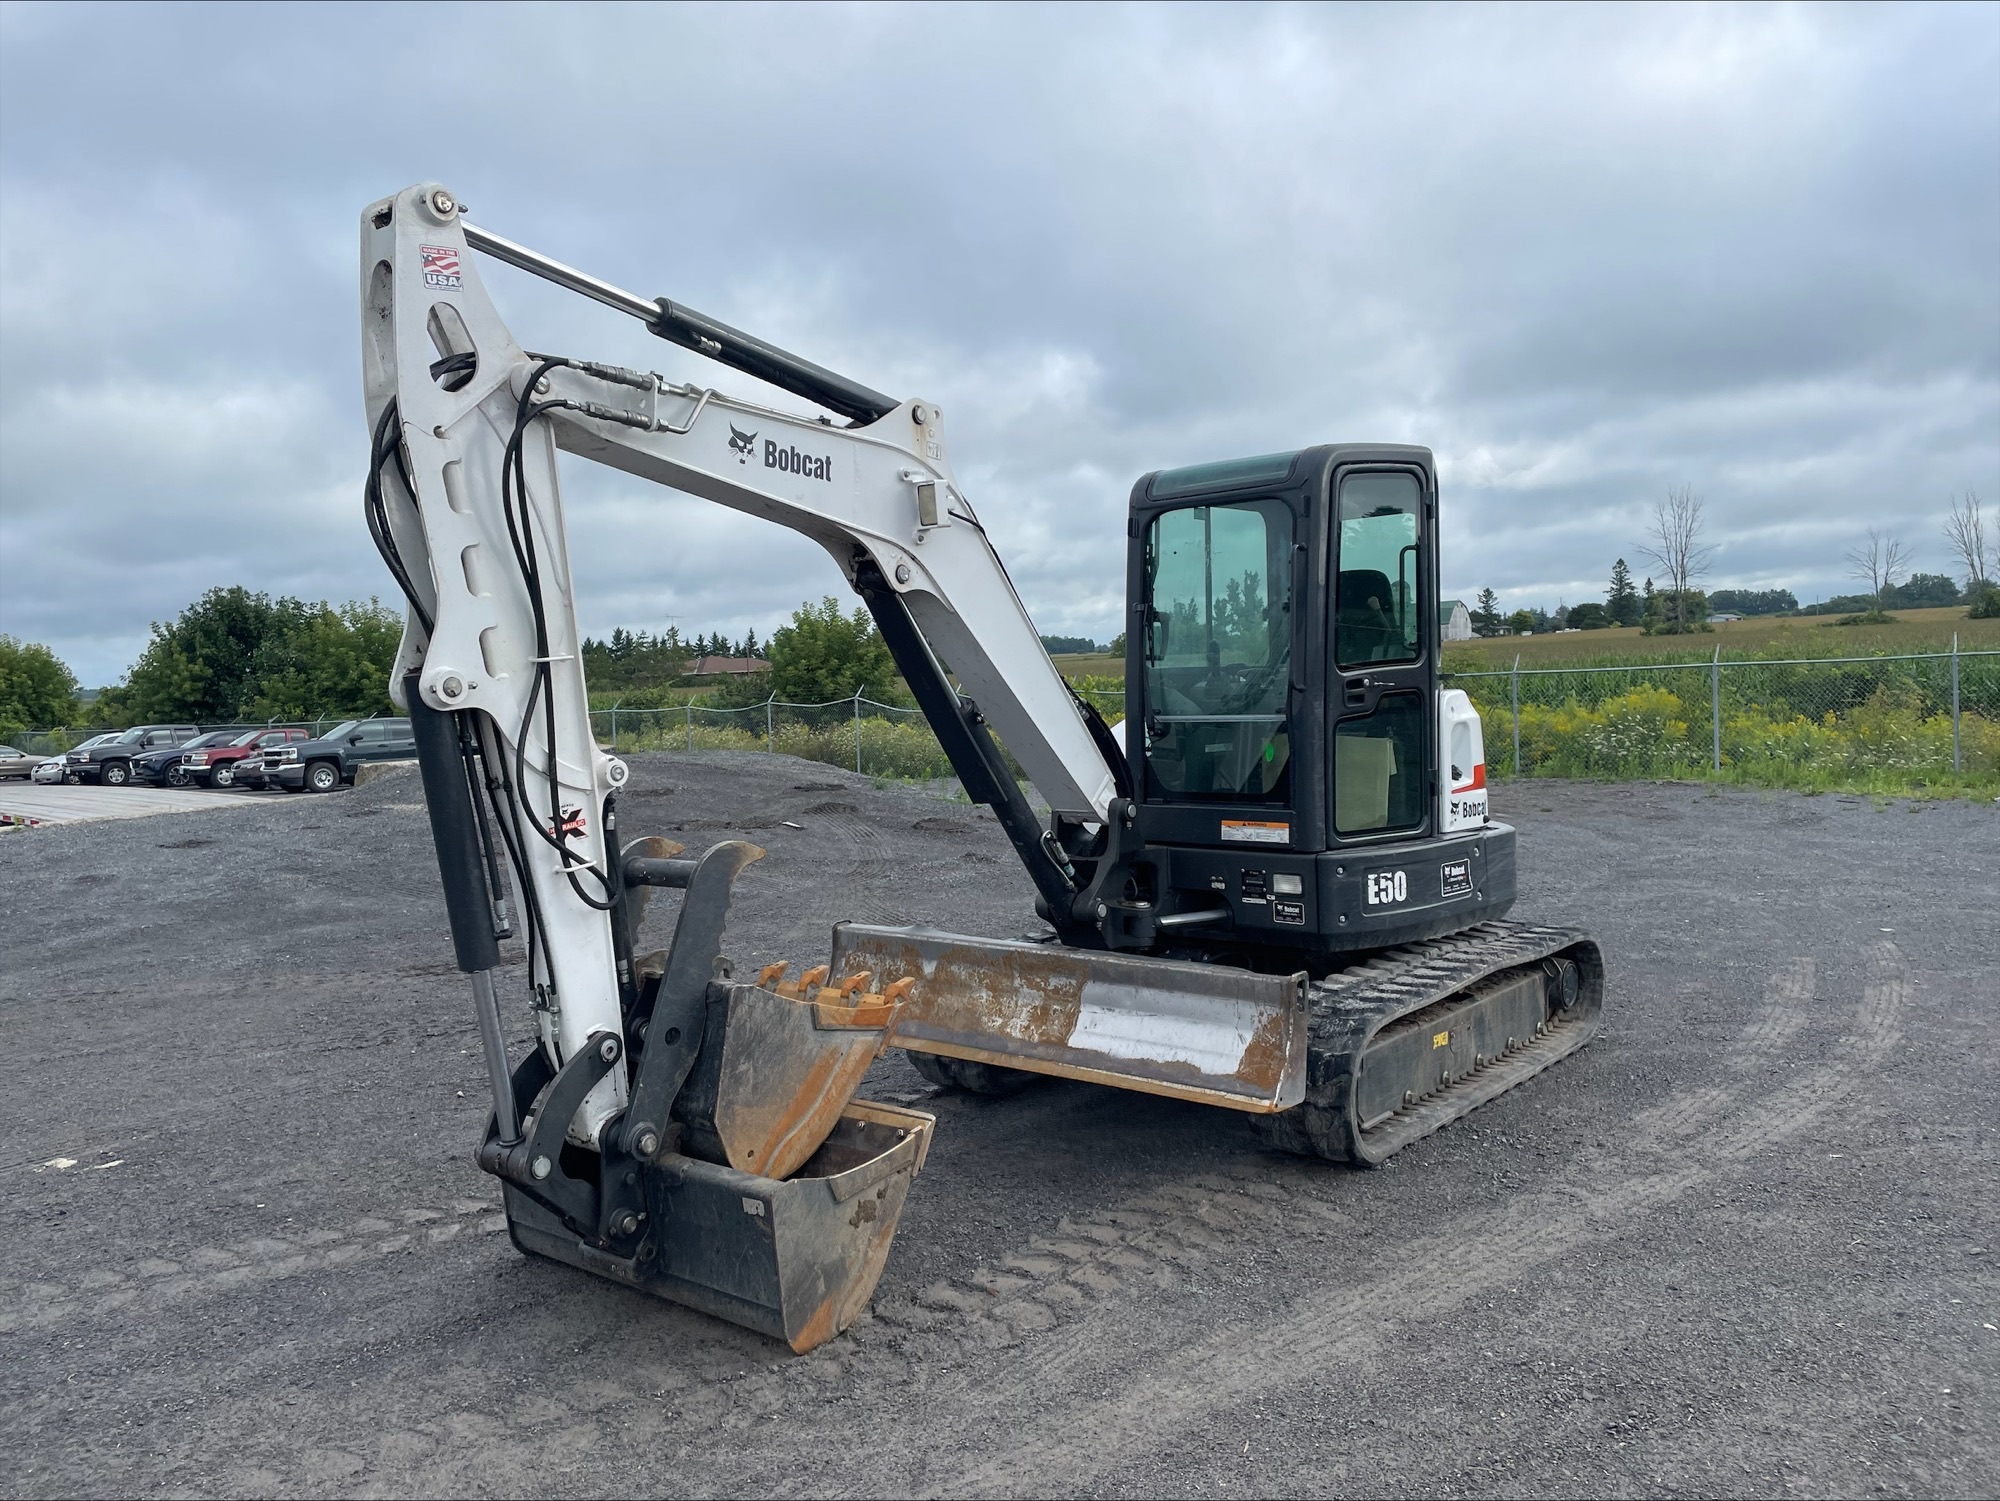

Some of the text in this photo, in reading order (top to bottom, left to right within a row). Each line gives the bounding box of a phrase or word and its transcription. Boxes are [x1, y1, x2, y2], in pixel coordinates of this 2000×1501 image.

[426, 274, 459, 286] USA
[764, 439, 832, 482] Bobcat
[1462, 799, 1487, 818] Bobcat
[549, 819, 585, 834] HRAULIC
[1367, 870, 1408, 905] E50
